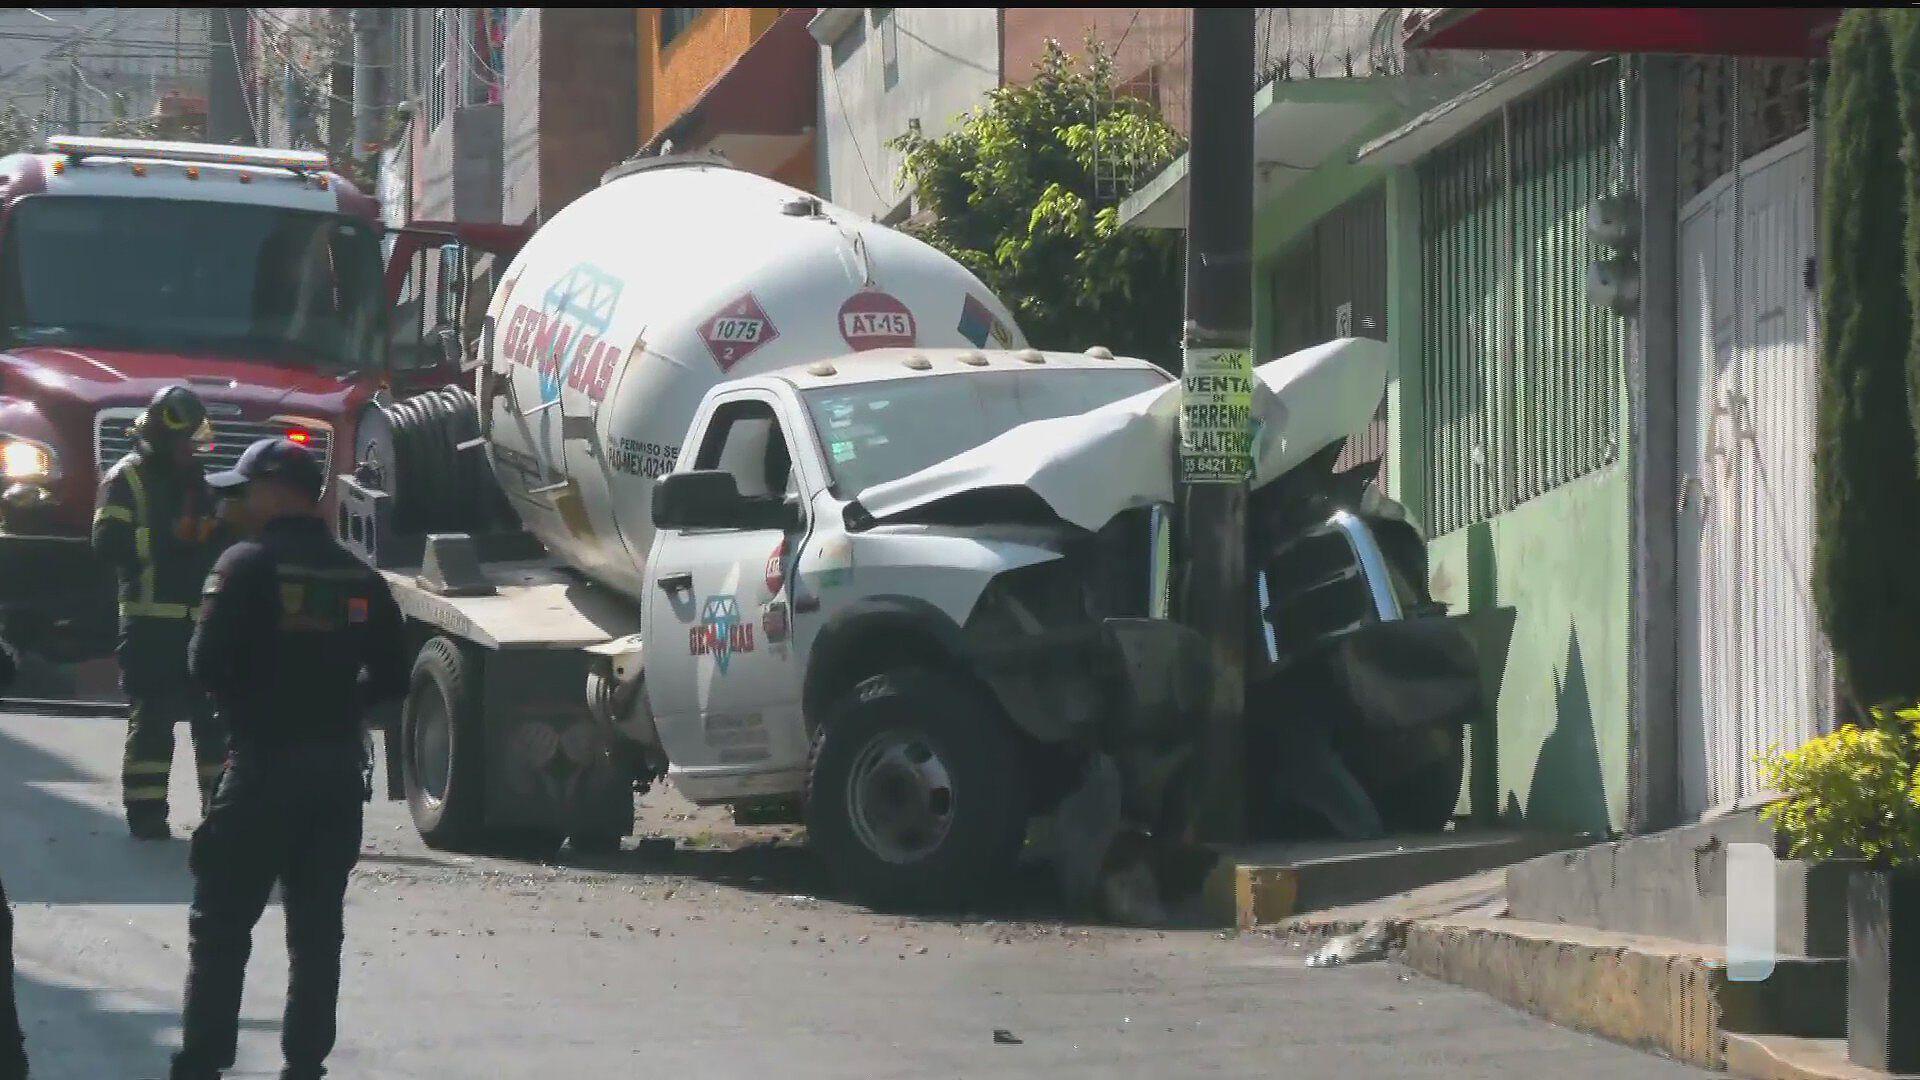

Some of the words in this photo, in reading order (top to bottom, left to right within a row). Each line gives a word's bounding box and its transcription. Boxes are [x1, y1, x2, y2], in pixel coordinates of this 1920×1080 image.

[716, 319, 760, 340] 1075
[852, 314, 906, 334] AT-15
[722, 347, 734, 360] 2
[1186, 375, 1252, 393] VENTA
[1212, 394, 1226, 403] DE
[620, 437, 661, 456] PERMISO
[663, 444, 681, 459] SE
[1197, 457, 1228, 472] 6421
